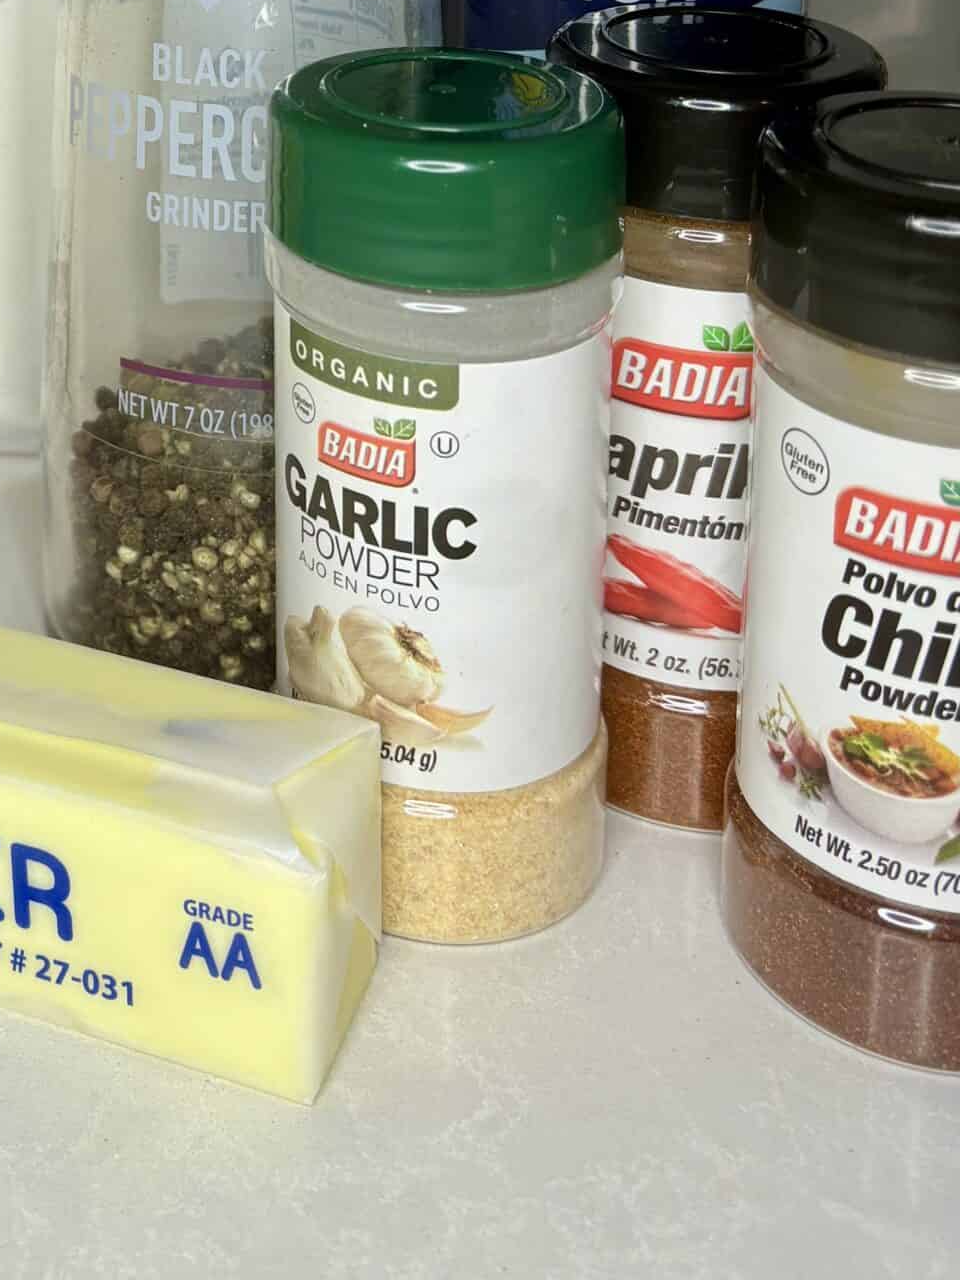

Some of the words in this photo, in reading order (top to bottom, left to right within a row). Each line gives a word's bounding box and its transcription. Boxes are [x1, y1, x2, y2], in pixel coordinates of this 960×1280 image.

[152, 42, 267, 89] BLACK
[145, 191, 265, 233] GRINDER
[295, 338, 439, 399] ORGANIC
[616, 348, 749, 408] BADIA
[118, 389, 147, 420] NET
[150, 399, 180, 427] WT
[183, 406, 195, 430] 7
[199, 407, 225, 434] OZ
[323, 427, 408, 480] BADIA
[784, 441, 825, 475] Gluten
[790, 459, 817, 484] Free
[285, 453, 479, 561] GARLIC
[612, 495, 745, 541] Pimentón
[844, 496, 960, 564] BADI
[301, 515, 440, 591] POWDER
[298, 549, 328, 579] AJO
[333, 570, 359, 594] EN
[366, 583, 441, 613] POLVO
[842, 557, 938, 608] Polvo
[613, 634, 640, 662] Wt.
[645, 647, 660, 668] 2
[663, 655, 691, 674] oz.
[698, 656, 740, 681] (56.
[418, 749, 438, 773] g)
[795, 814, 824, 849] Net
[826, 831, 853, 864] Wt.
[857, 850, 902, 881] 2.50
[905, 869, 931, 888] oz
[183, 898, 255, 932] GRADE
[10, 947, 27, 974] #
[35, 954, 134, 1007] 27-031
[178, 921, 263, 991] AA
